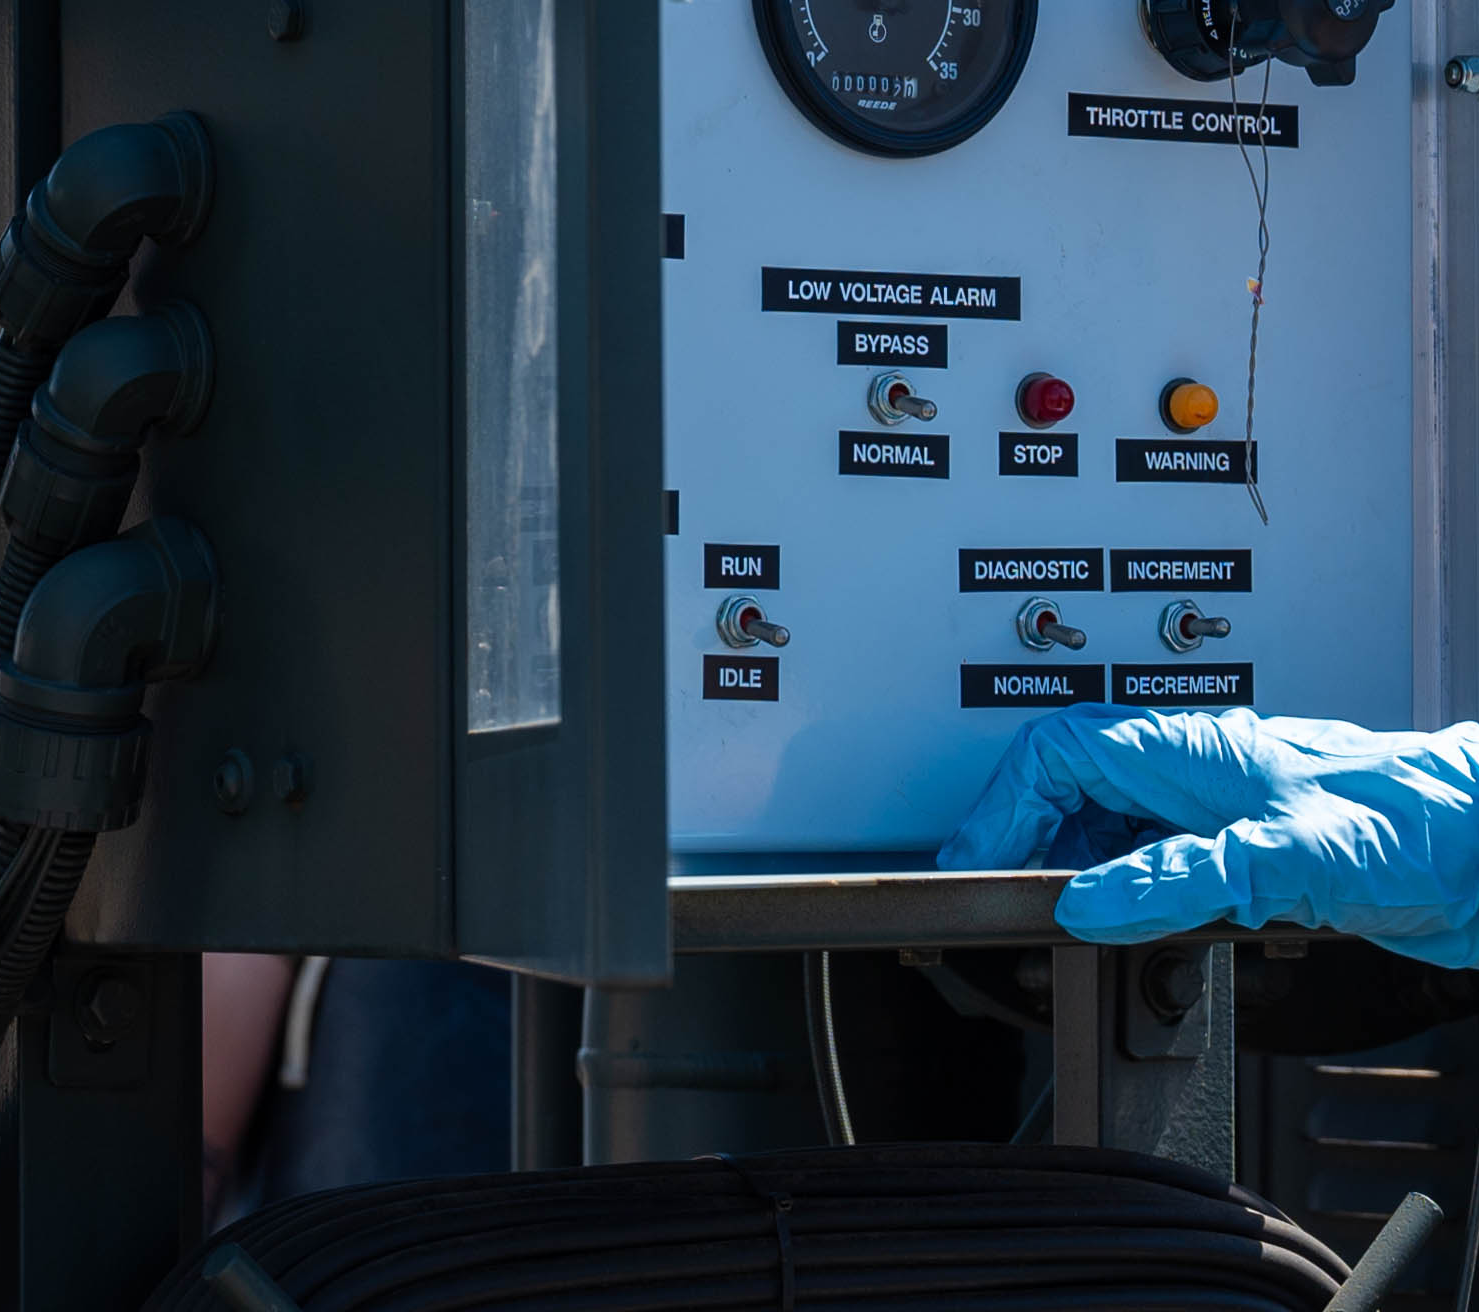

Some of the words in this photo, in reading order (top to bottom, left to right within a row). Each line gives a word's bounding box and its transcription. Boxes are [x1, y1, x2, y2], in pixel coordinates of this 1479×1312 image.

[962, 9, 981, 27] 30
[939, 62, 958, 81] 35
[1085, 106, 1184, 130] THROTTLE
[1191, 112, 1282, 135] CONTROL
[787, 280, 832, 301] LOW
[839, 282, 922, 304] VOLTAGE
[929, 287, 996, 307] ALARM
[854, 333, 929, 355] BYPASS
[852, 443, 934, 466] NORMAL
[1013, 444, 1063, 465] STOP
[1144, 451, 1230, 472] WARNING
[721, 555, 762, 577] RUN
[974, 559, 1090, 580] DIAGNOSTIC
[1127, 560, 1235, 580] INCREMENT
[719, 667, 762, 689] IDLE
[993, 675, 1074, 696] NORMAL
[1125, 675, 1240, 696] DECREMENT
